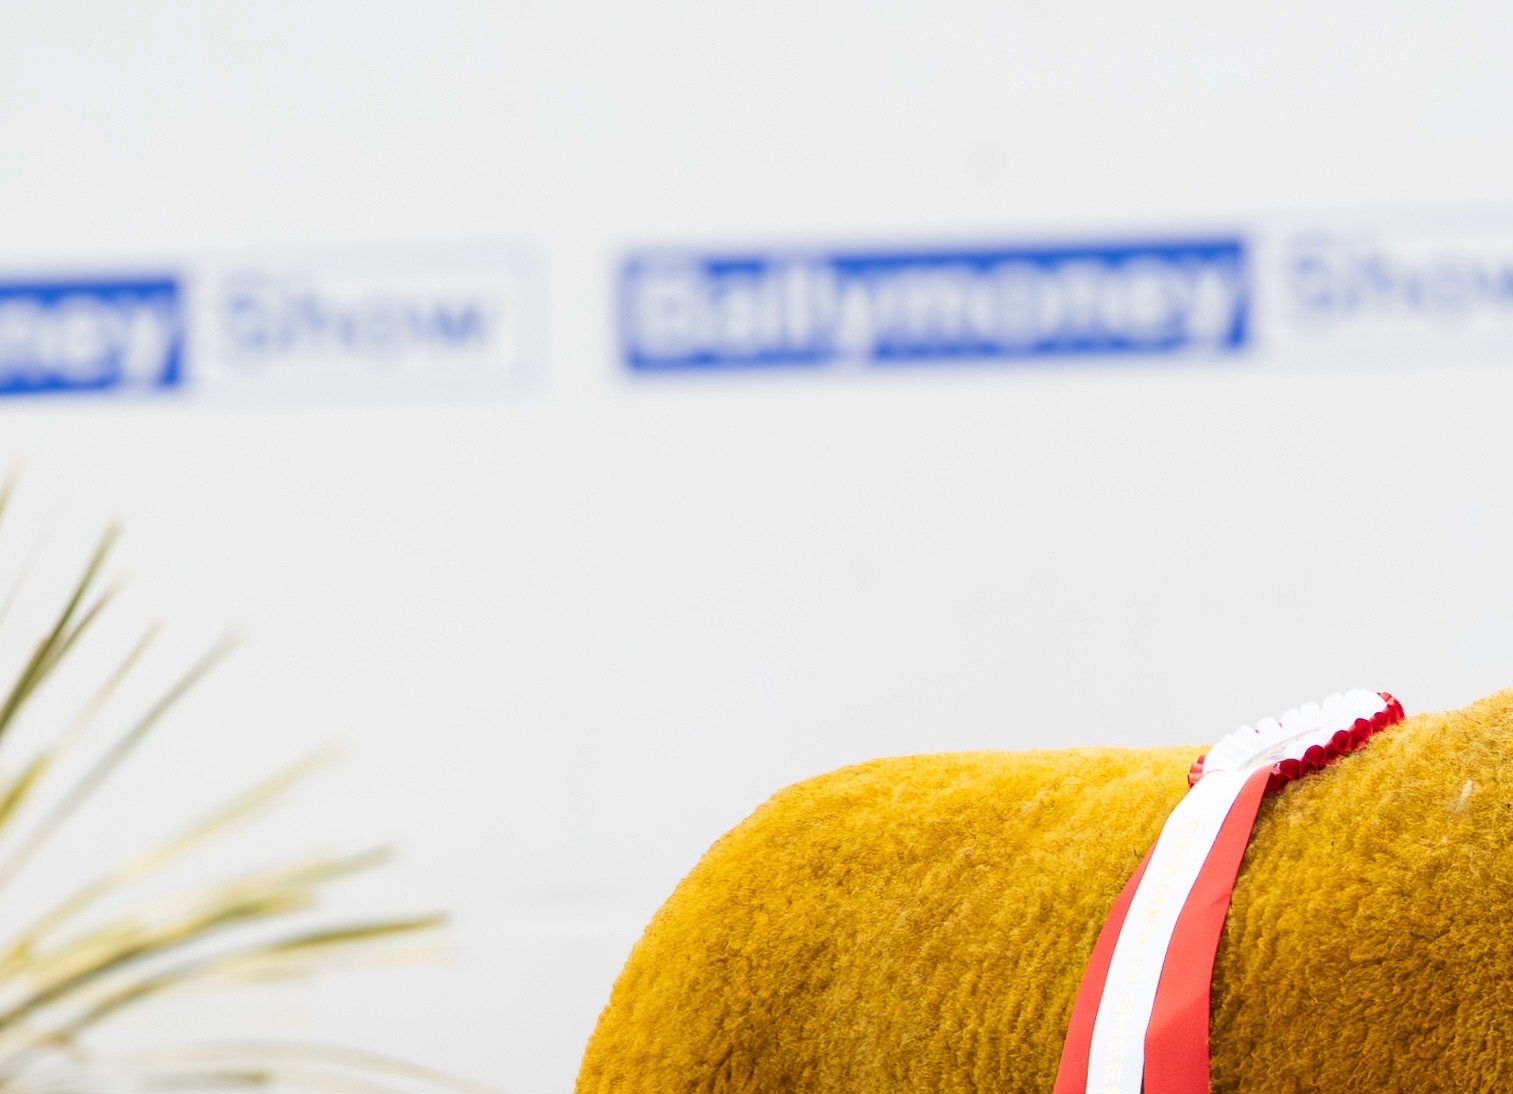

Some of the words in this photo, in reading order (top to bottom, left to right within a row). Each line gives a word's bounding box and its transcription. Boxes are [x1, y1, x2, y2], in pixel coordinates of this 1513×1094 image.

[217, 267, 501, 368] Show
[625, 250, 1243, 370] Ballymoney
[1123, 819, 1202, 984] CHAMPION
